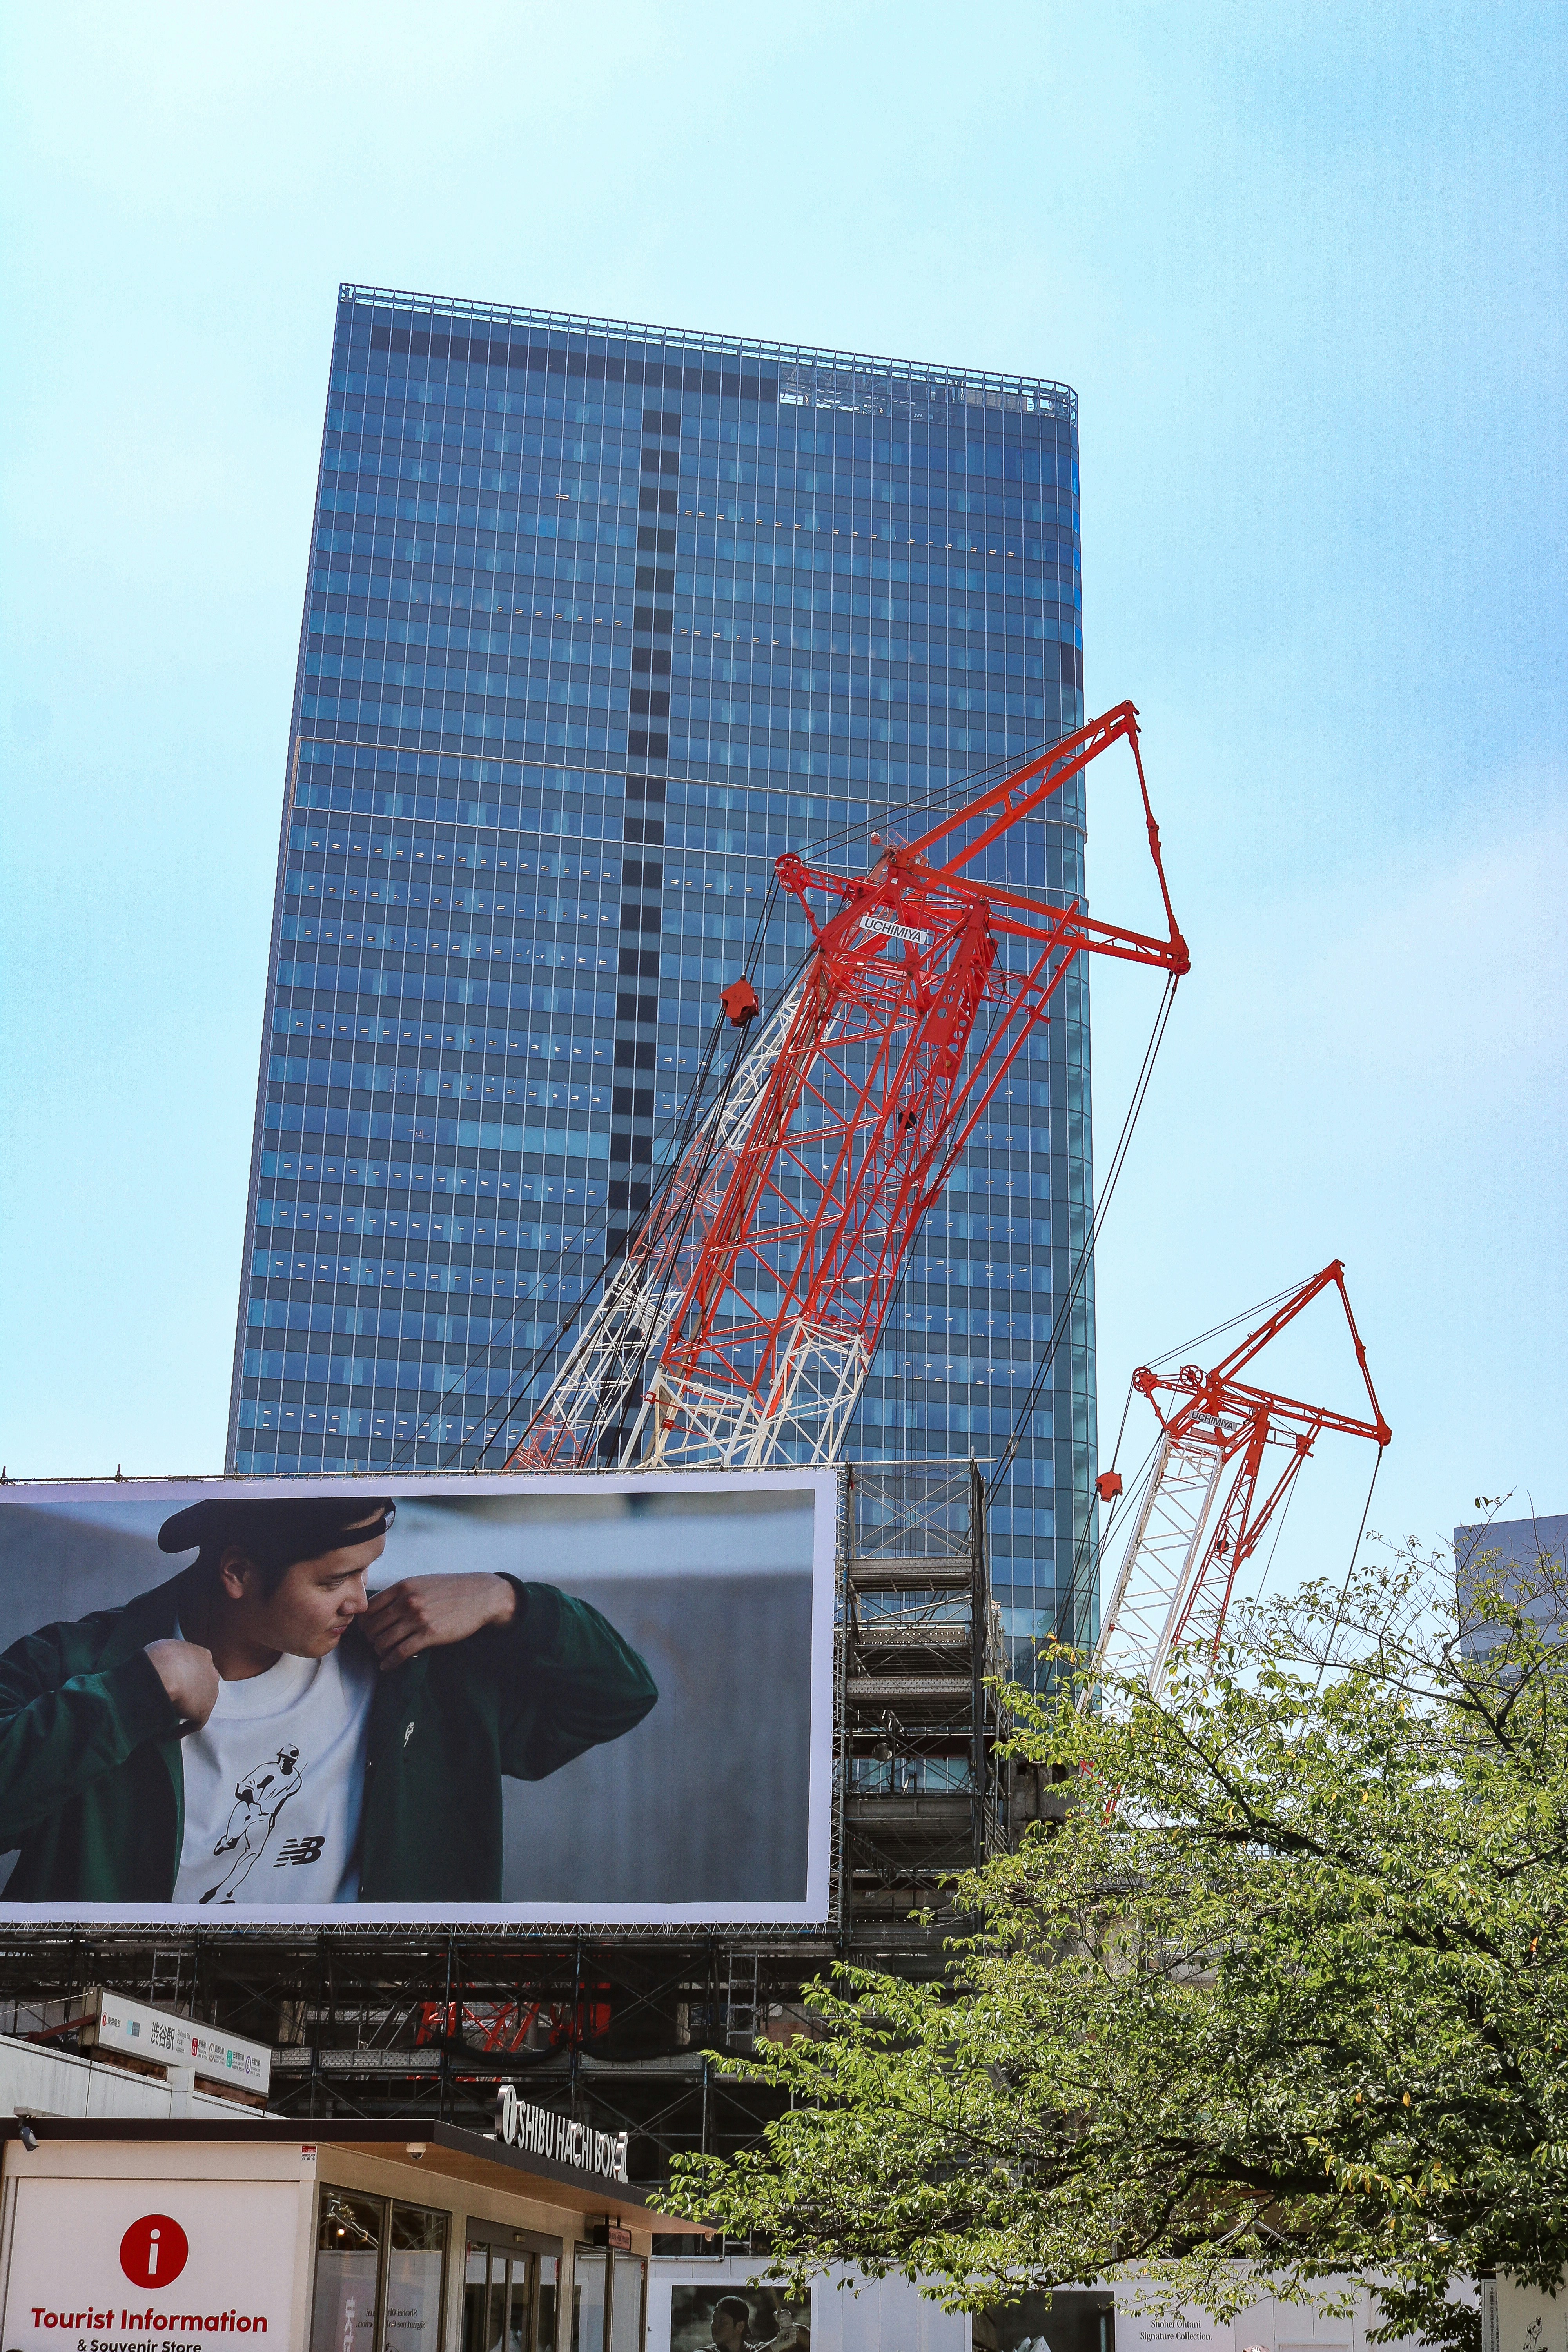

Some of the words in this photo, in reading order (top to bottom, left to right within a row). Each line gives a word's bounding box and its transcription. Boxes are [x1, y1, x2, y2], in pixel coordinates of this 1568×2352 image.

[864, 918, 921, 942] UCHIMIYA
[1191, 1411, 1233, 1430] UCHIMIYA
[151, 2021, 175, 2050] 渋谷駅
[192, 2046, 196, 2054] 01
[517, 2100, 555, 2158] SHIBU
[556, 2115, 592, 2171] HACHI
[595, 2130, 617, 2179] BOX
[31, 2306, 115, 2329] Tourist
[121, 2307, 268, 2333] Information
[1151, 2319, 1175, 2328] Shohei
[1177, 2320, 1201, 2328] Ohtani
[77, 2339, 87, 2352] &
[90, 2339, 158, 2352] Souvenir
[161, 2340, 202, 2352] Store
[1140, 2332, 1174, 2342] Signature
[1176, 2332, 1212, 2340] Collection.
